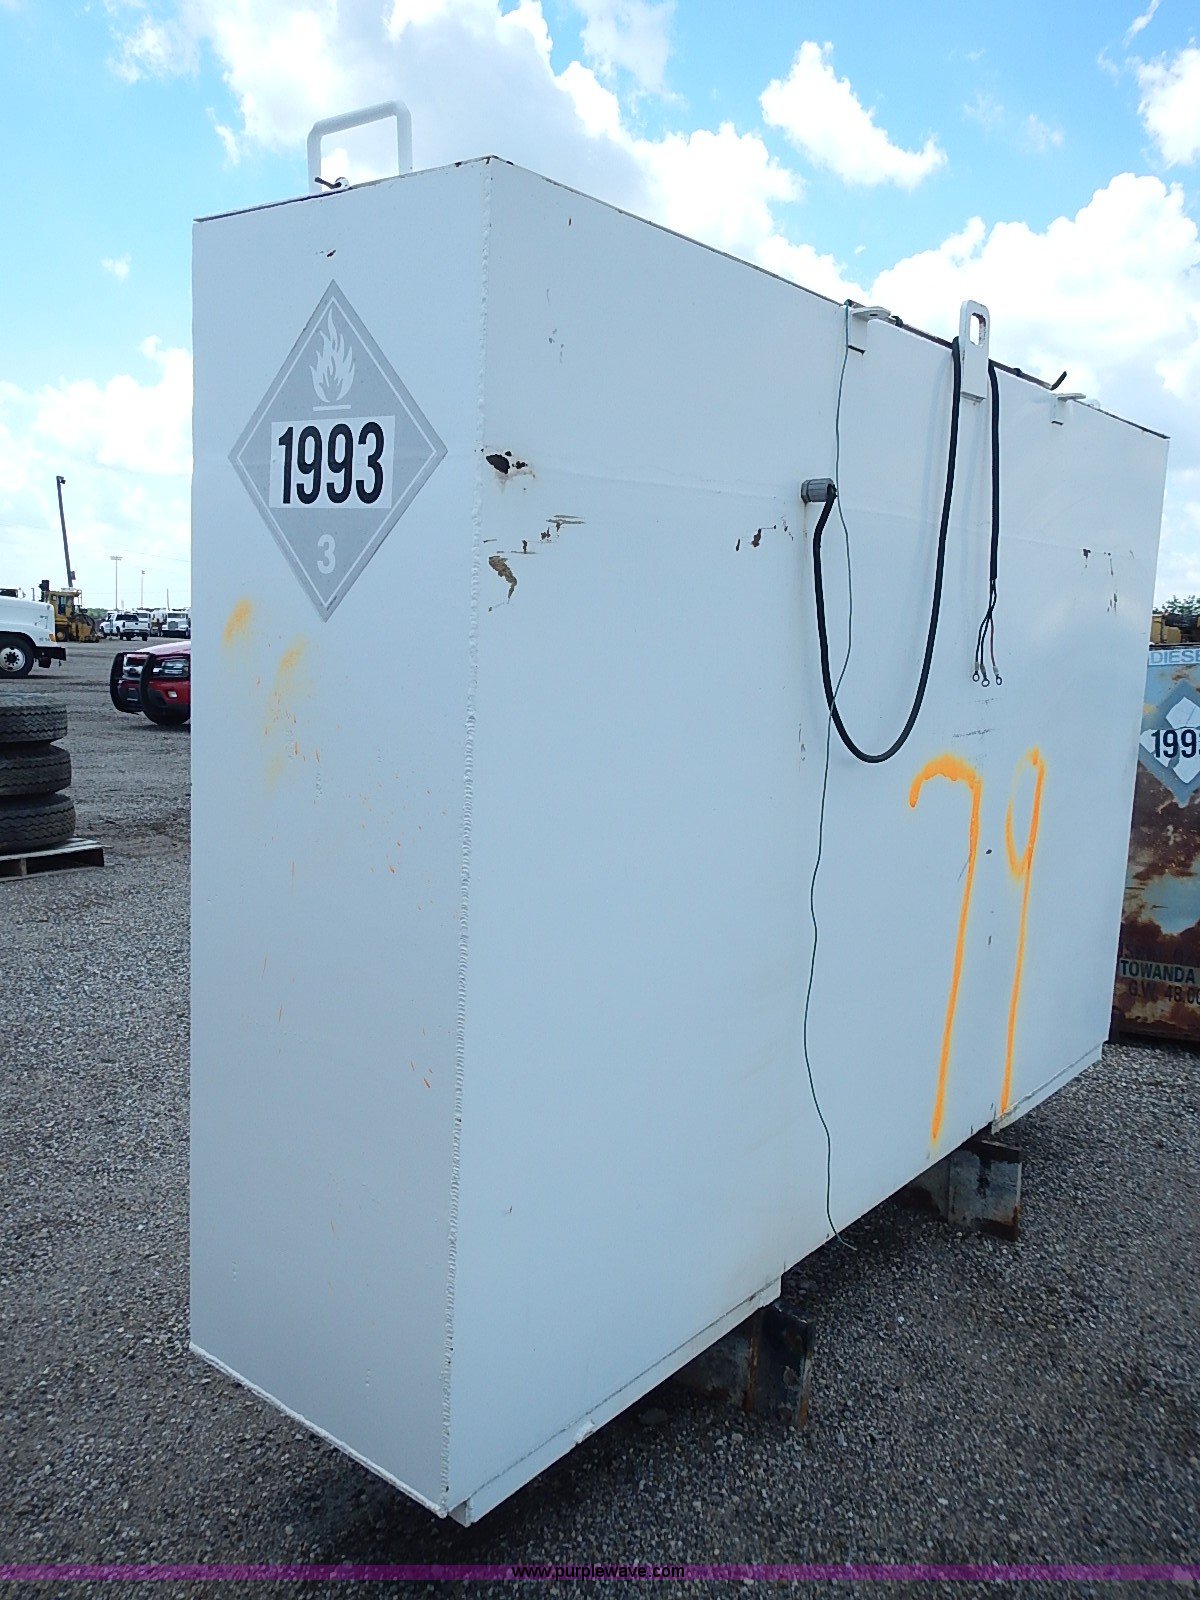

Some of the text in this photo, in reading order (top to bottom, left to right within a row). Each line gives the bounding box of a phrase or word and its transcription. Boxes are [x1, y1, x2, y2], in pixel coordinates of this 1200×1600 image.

[278, 421, 385, 505] 1993
[317, 534, 336, 574] 3
[1151, 729, 1200, 759] 199
[909, 747, 1046, 1146] 79
[1120, 960, 1195, 983] TOWANDA
